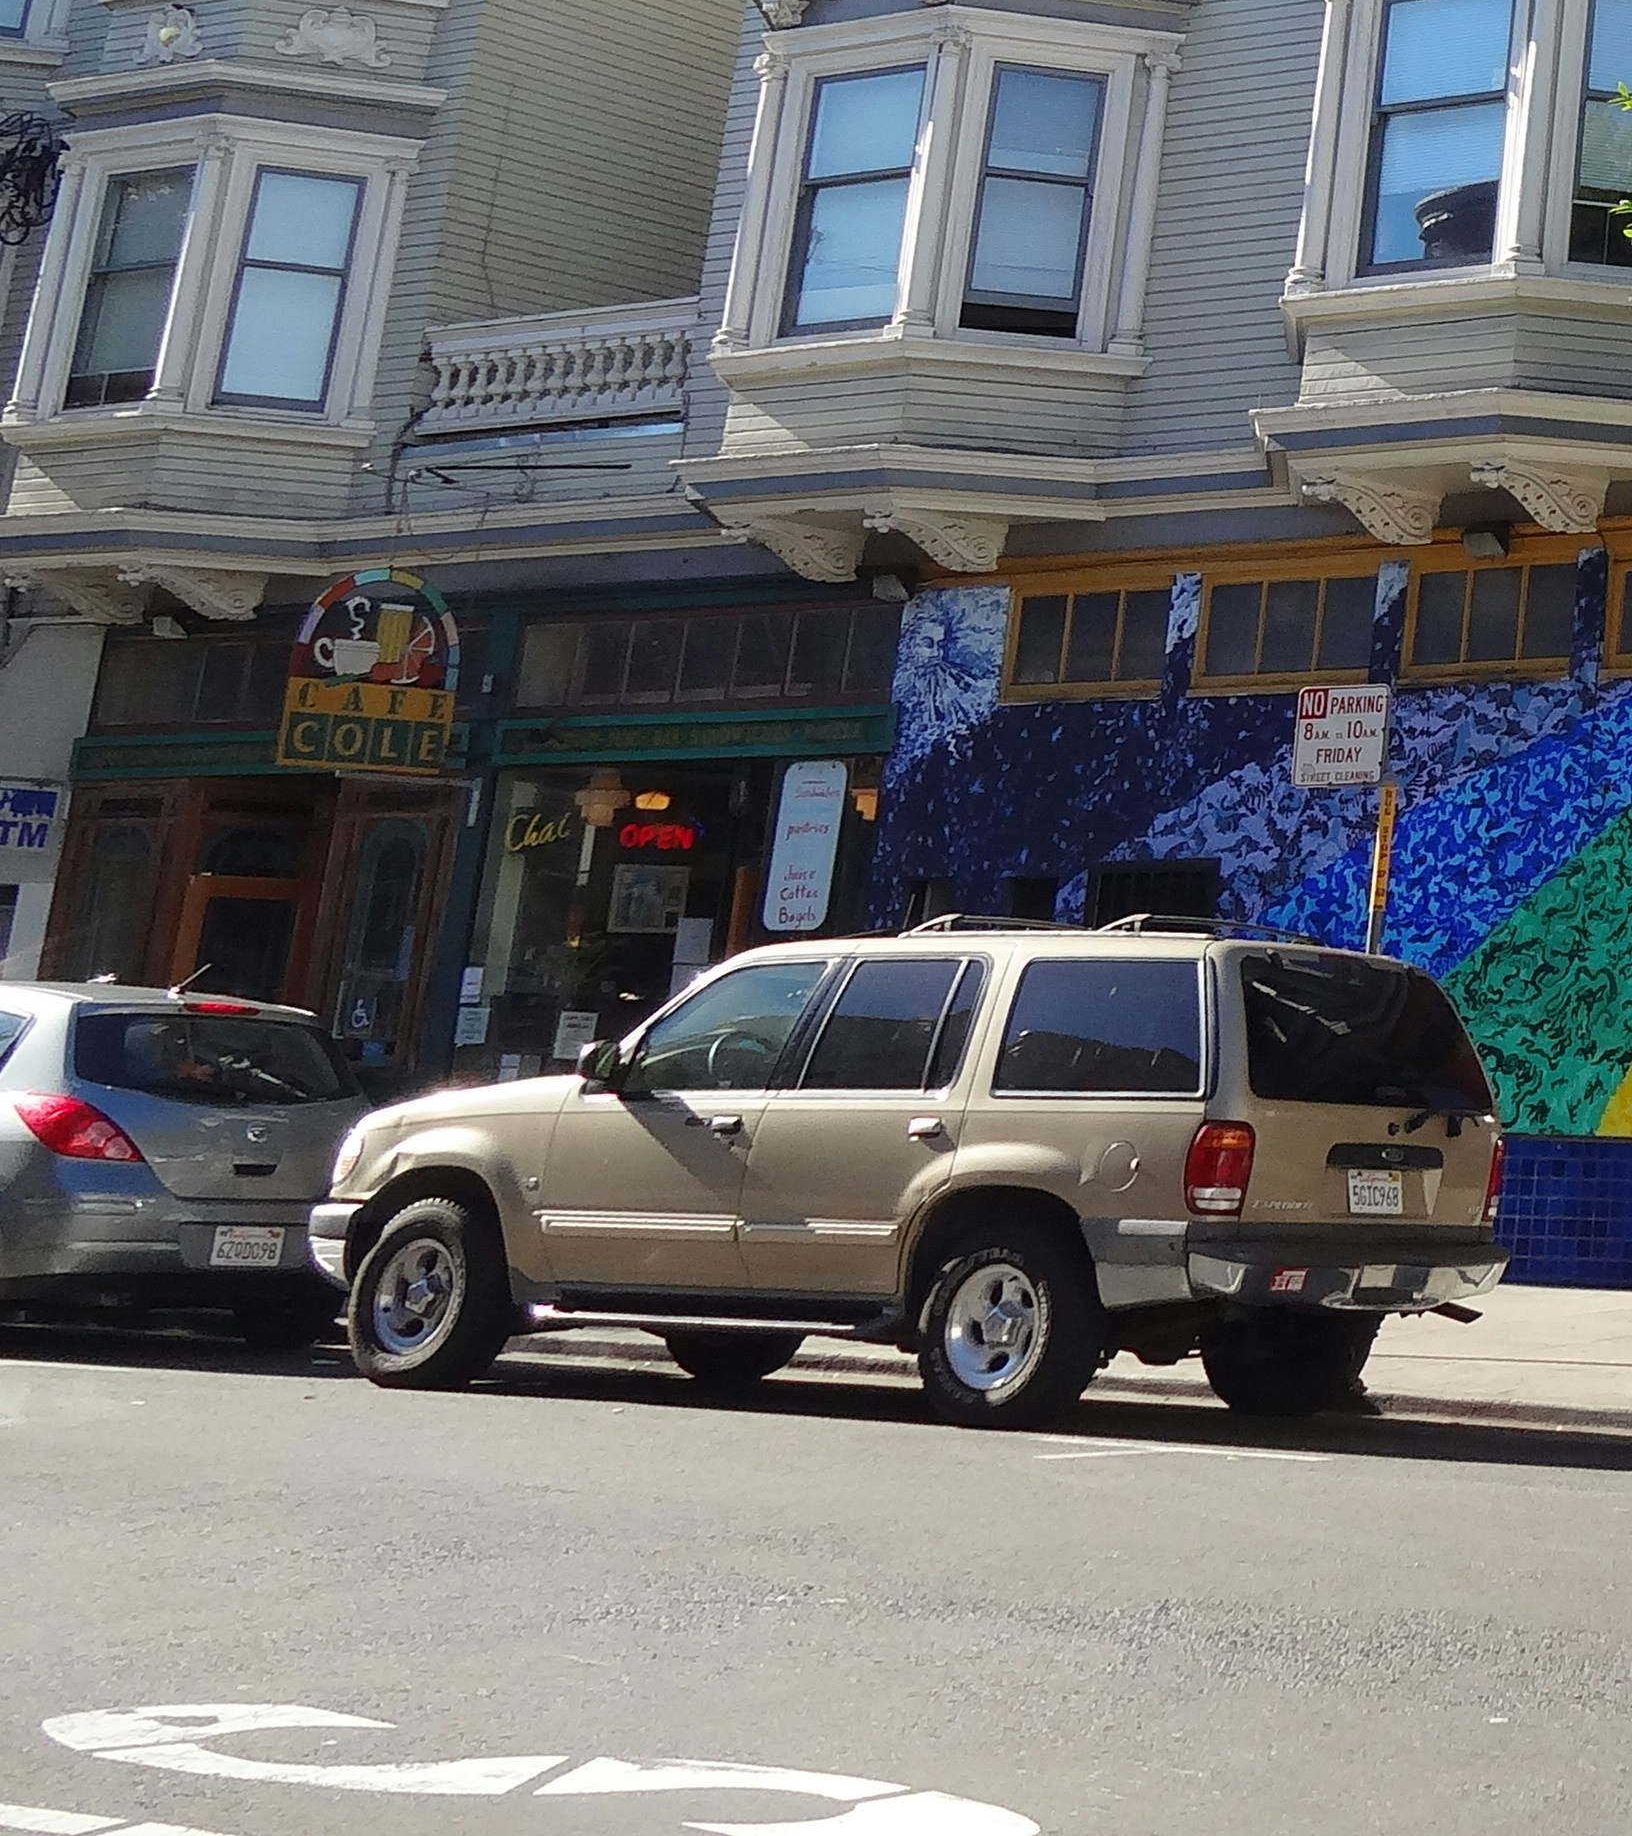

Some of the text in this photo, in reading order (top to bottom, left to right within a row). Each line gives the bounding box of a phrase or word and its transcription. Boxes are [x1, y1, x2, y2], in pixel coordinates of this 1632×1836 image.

[297, 682, 449, 720] CAFE
[1302, 690, 1384, 717] NO PARKING
[292, 720, 438, 761] COLE
[1316, 746, 1362, 765] FRIDAY
[1300, 770, 1375, 783] STREET CLEANING
[505, 813, 570, 851] Chai
[618, 823, 696, 851] OPEN
[777, 905, 817, 928] Bagels
[1353, 1184, 1399, 1207] 5GIC968
